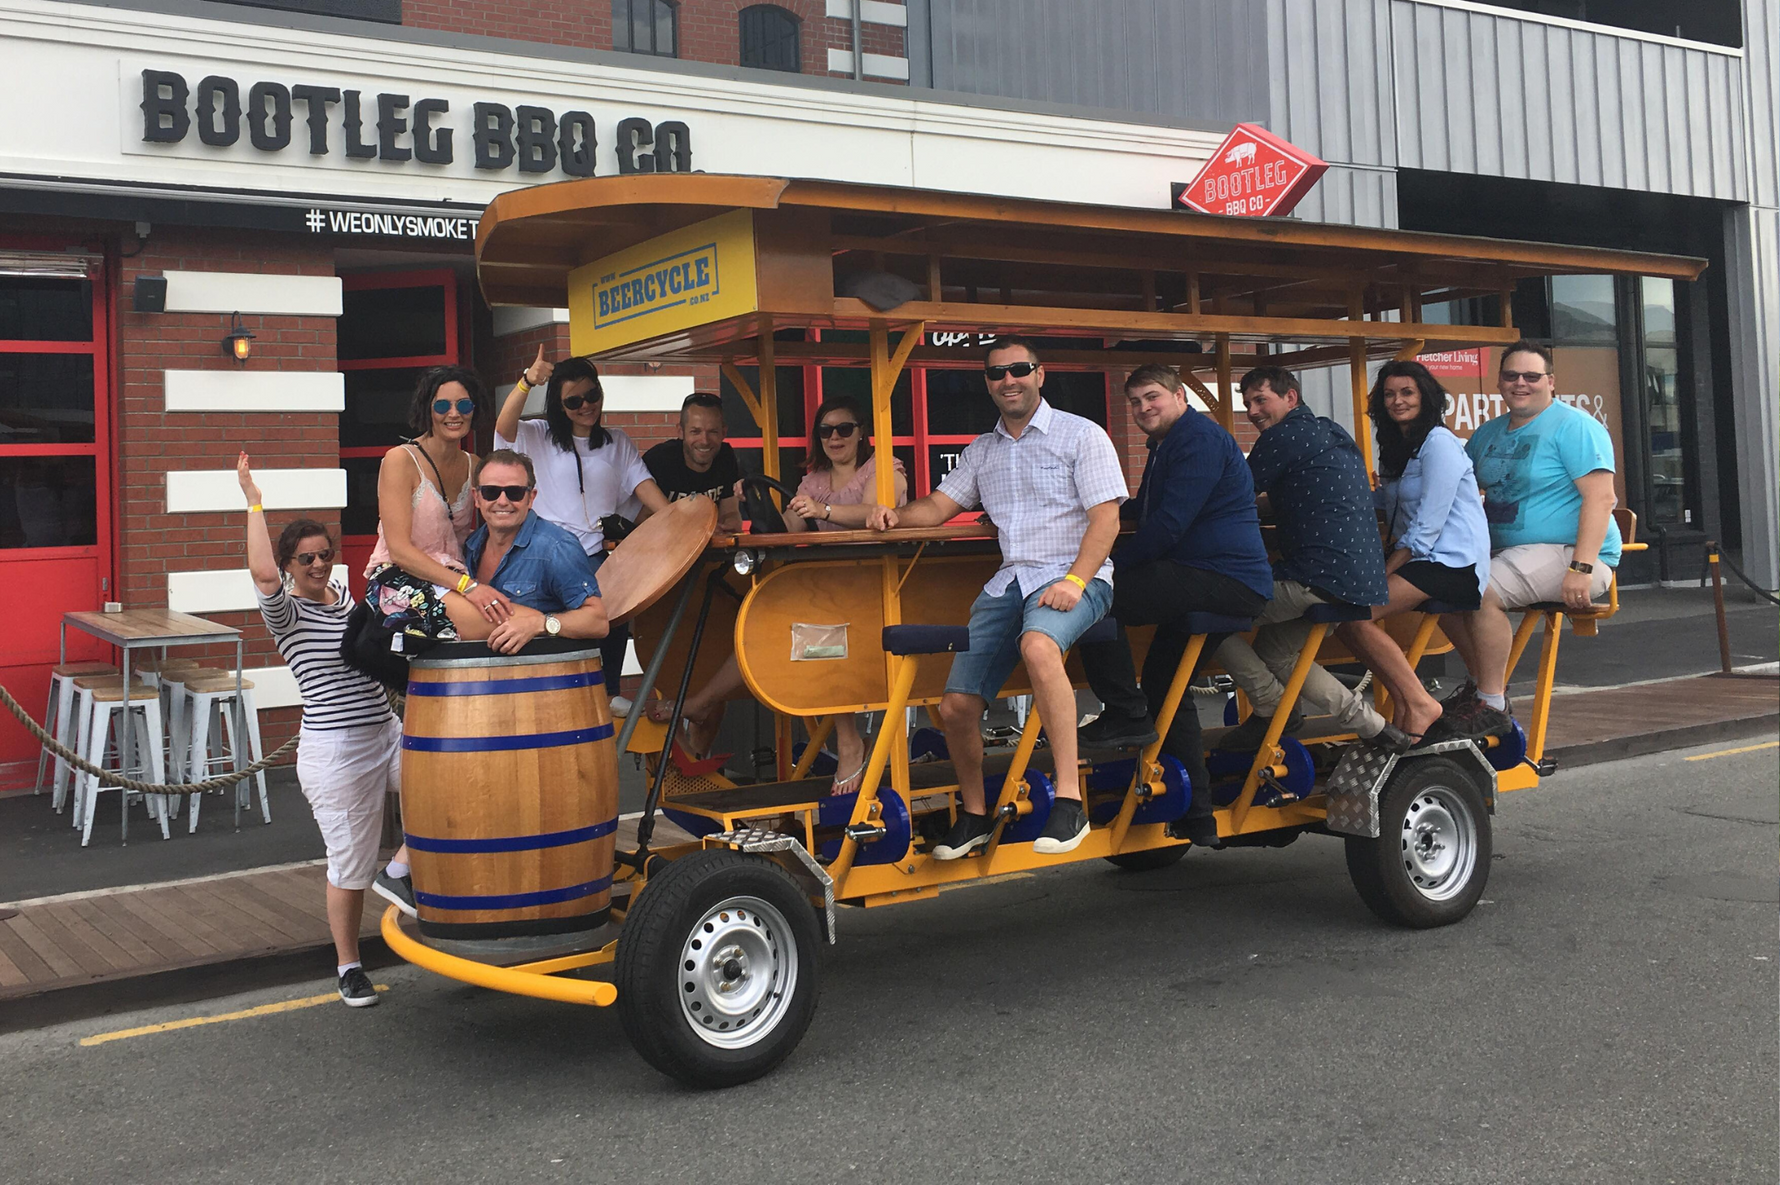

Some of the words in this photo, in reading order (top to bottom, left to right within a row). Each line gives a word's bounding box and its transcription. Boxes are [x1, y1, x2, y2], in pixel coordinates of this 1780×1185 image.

[140, 69, 454, 165] BOOTLEG
[472, 101, 598, 177] BBQ
[615, 117, 705, 173] CO
[1204, 160, 1287, 203] BOOTLEG
[1225, 198, 1247, 215] BBQ
[1249, 195, 1264, 211] CO
[598, 256, 710, 317] BEERCYCLE
[1453, 351, 1478, 366] Living
